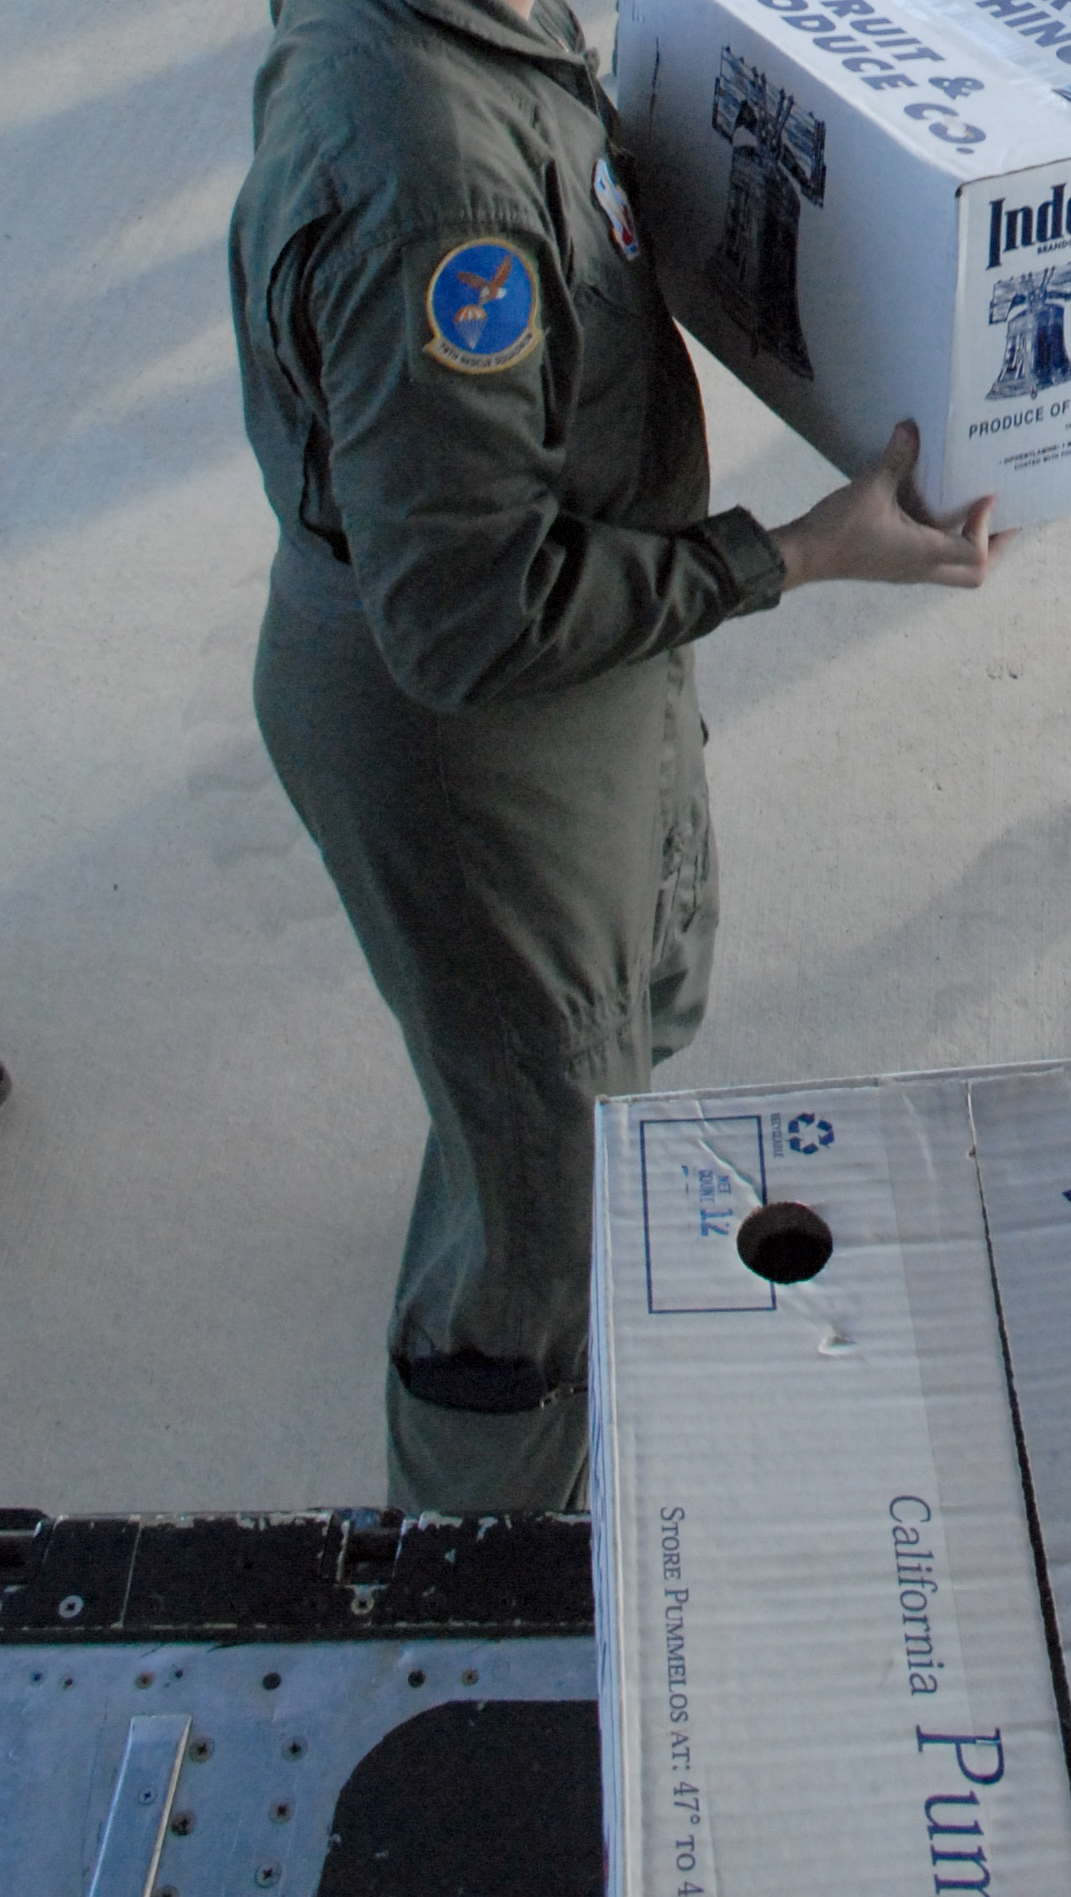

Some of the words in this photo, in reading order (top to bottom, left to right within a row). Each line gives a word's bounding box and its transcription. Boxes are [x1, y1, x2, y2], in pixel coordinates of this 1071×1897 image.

[928, 76, 985, 100] &
[903, 102, 987, 155] CO.
[969, 409, 1045, 440] PRODUCE
[1050, 399, 1071, 417] OF
[700, 1207, 733, 1237] 12
[660, 1505, 685, 1580] STORE
[889, 1494, 945, 1697] California
[664, 1586, 689, 1723] PUMMELOS
[670, 1731, 691, 1772] AT:
[675, 1834, 696, 1872] TO
